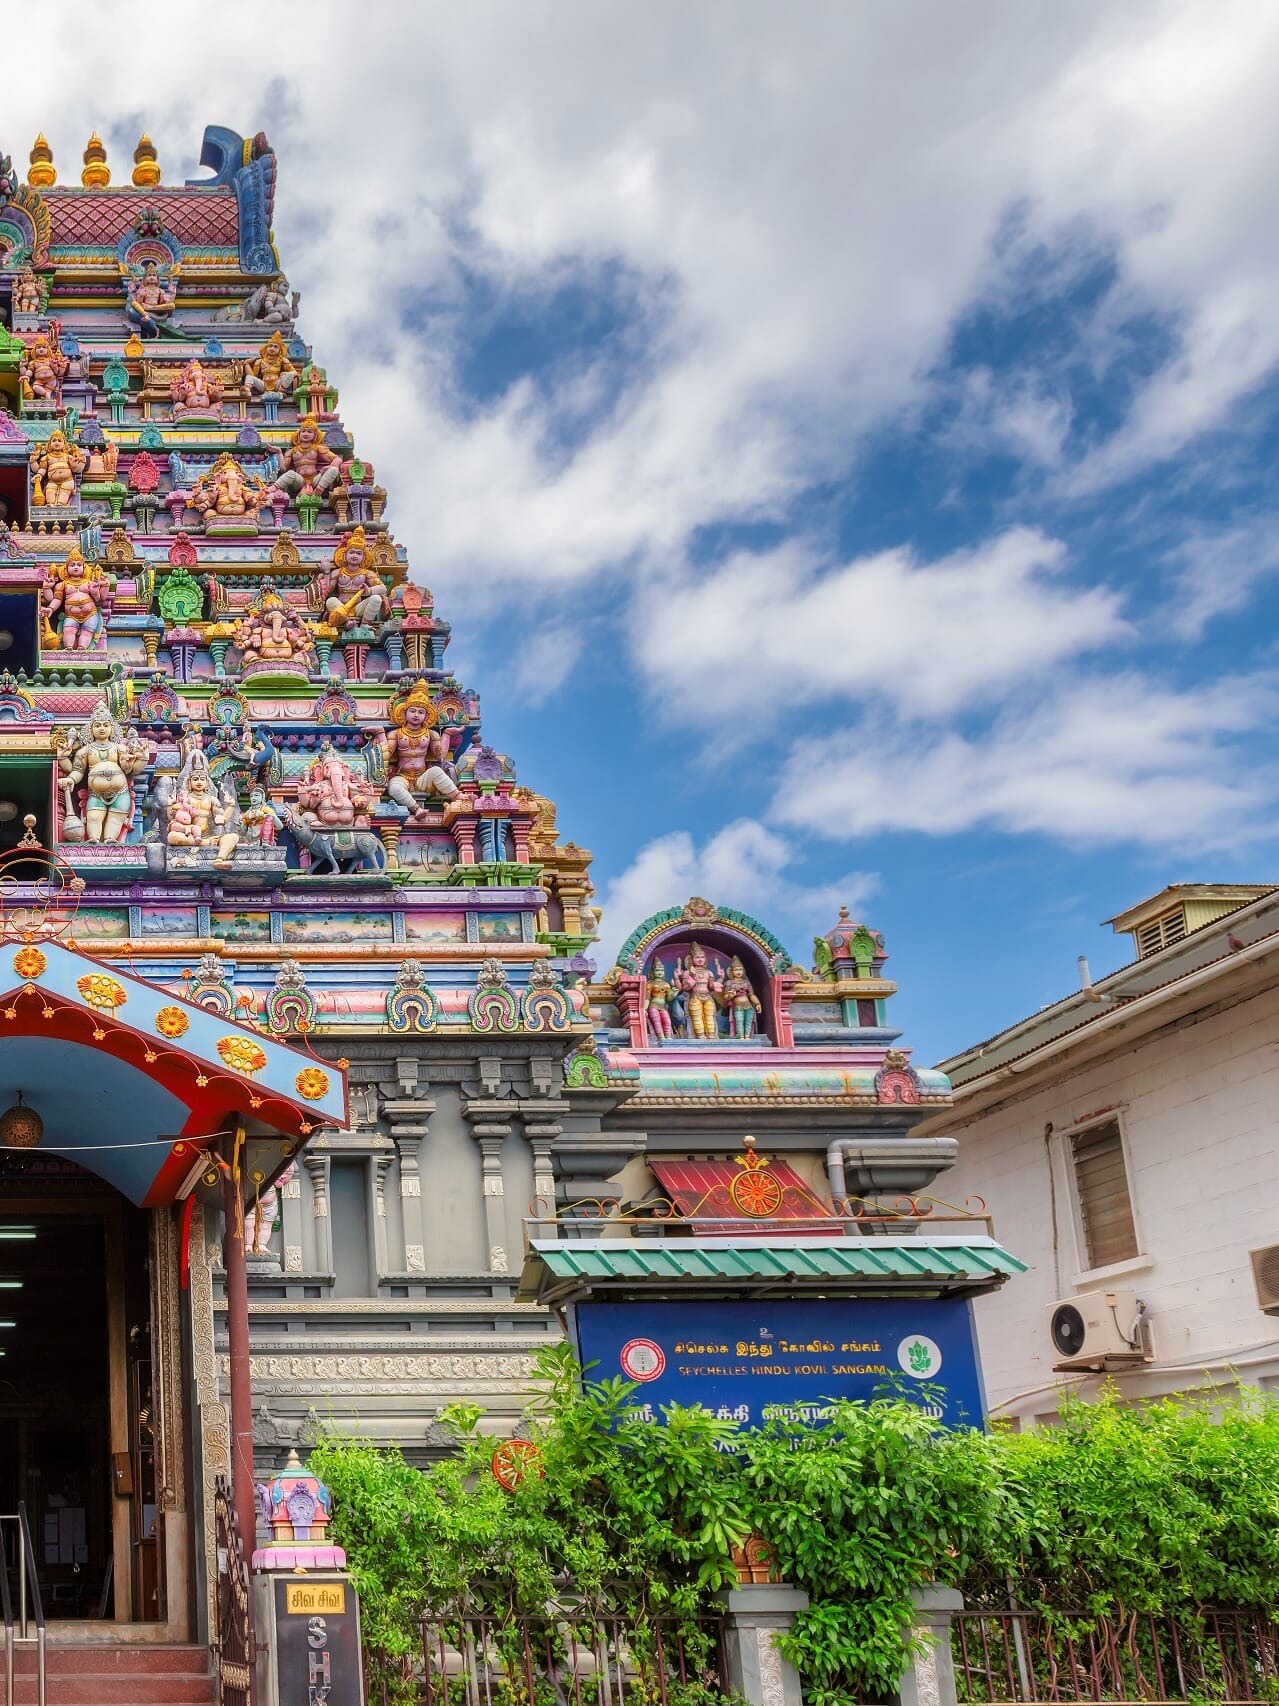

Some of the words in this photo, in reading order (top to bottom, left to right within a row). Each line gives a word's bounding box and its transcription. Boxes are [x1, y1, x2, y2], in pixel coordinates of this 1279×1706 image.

[736, 1340, 773, 1357] இந்து
[778, 1340, 835, 1354] கோவில்
[840, 1340, 881, 1353] சங்கம்
[678, 1366, 748, 1376] SEYCHELLES
[751, 1366, 790, 1375] HINDU
[794, 1365, 829, 1375] KOVIL
[832, 1364, 886, 1375] SANGAM
[292, 1590, 315, 1608] சிவ
[319, 1590, 341, 1608] சிவ
